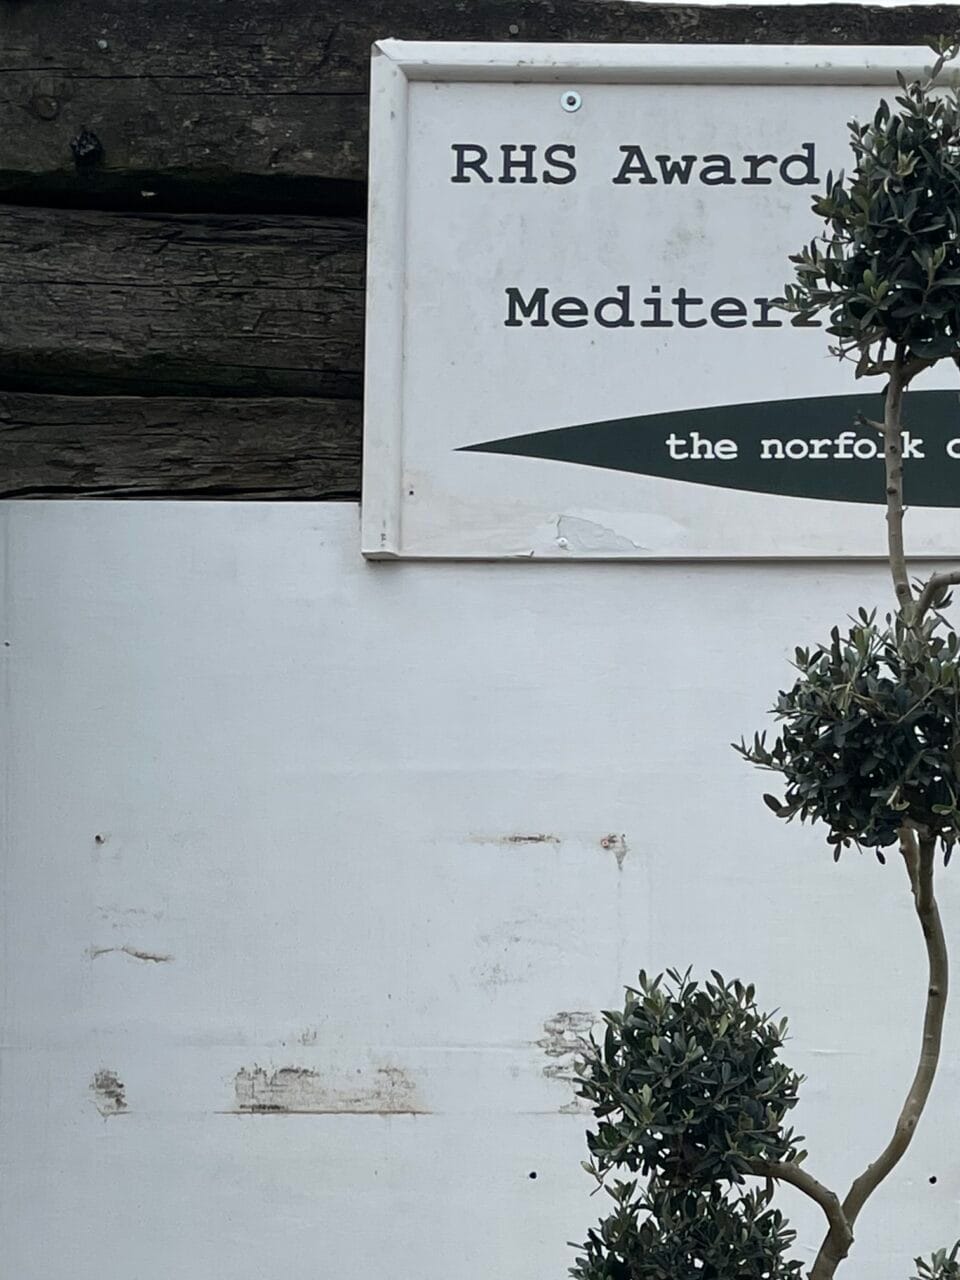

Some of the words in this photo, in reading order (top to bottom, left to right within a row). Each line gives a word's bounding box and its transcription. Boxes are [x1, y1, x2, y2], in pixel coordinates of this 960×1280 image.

[450, 143, 577, 185] RHS
[612, 142, 821, 186] Award
[665, 431, 738, 460] the
[760, 431, 925, 460] norfok
